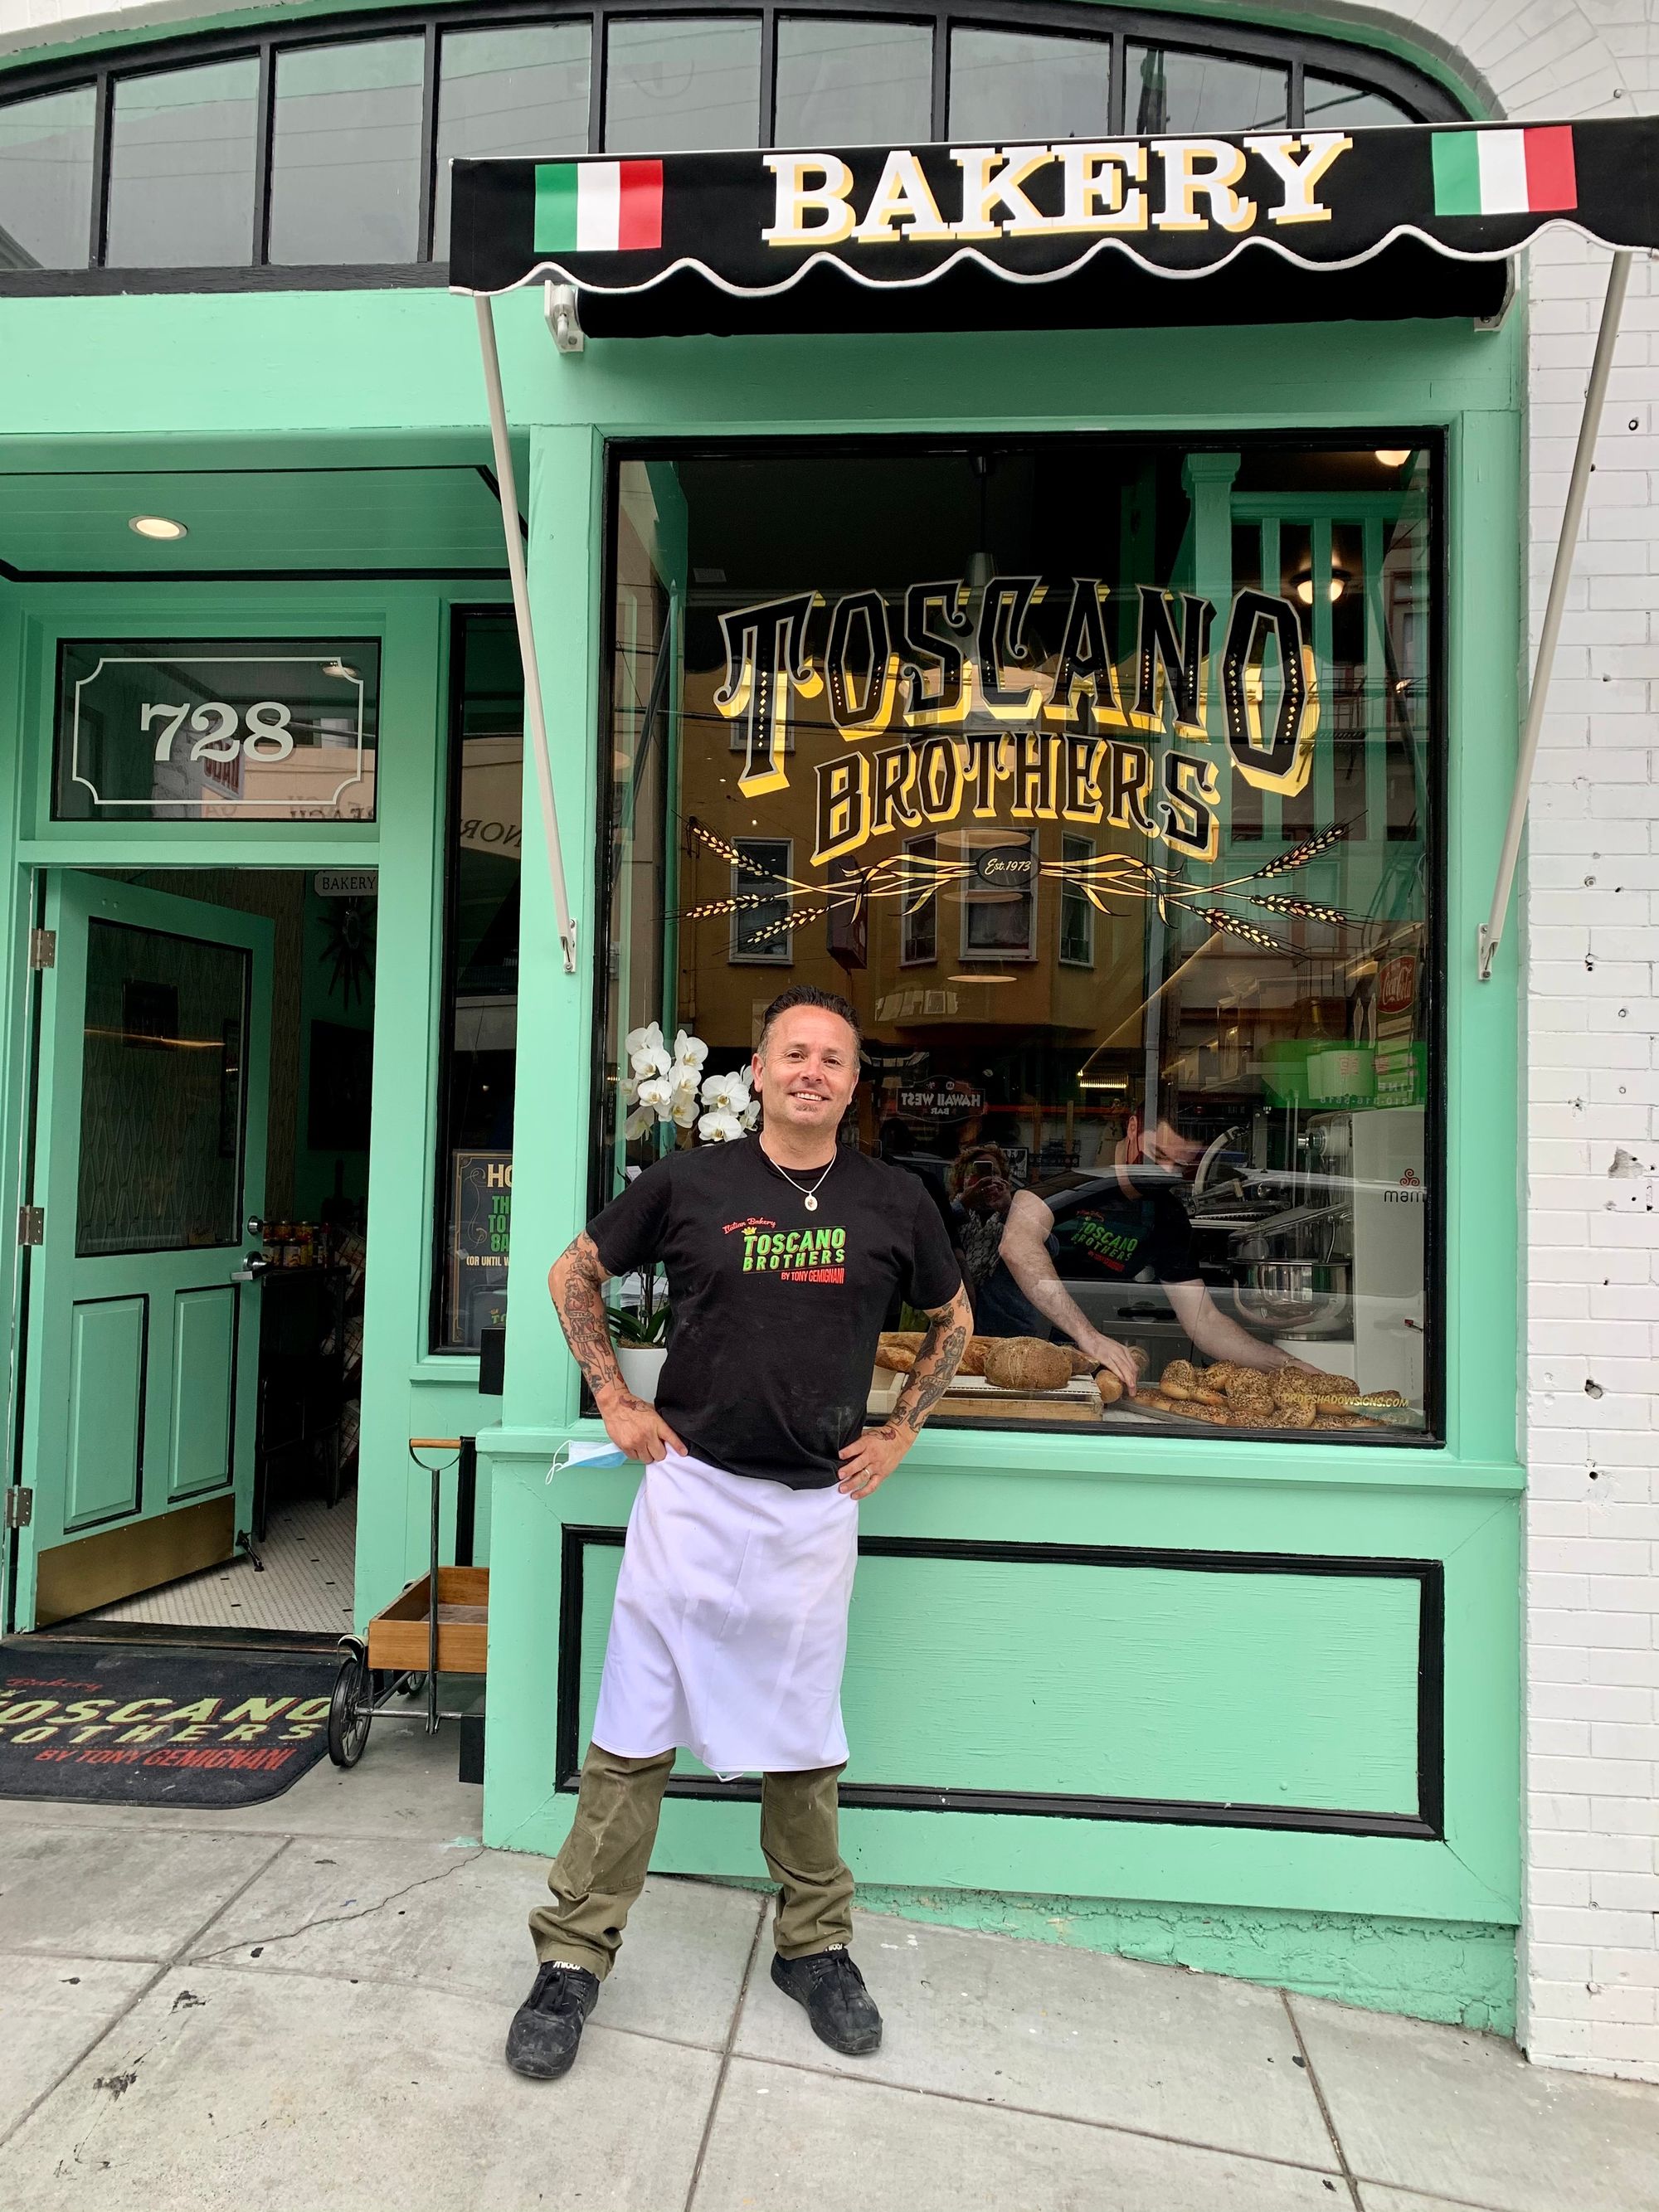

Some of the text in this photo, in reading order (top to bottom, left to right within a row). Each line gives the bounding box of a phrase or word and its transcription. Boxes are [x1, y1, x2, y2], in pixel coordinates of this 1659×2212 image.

[761, 131, 1354, 246] BAKERY
[713, 575, 1321, 798] TOSCANO
[140, 701, 294, 762] 728
[810, 731, 1220, 866] BROTHERS
[322, 876, 377, 890] BAKERY
[488, 1214, 507, 1233] TO
[747, 1217, 776, 1228] Bakery
[743, 1228, 846, 1256] TOSCANO
[1078, 1222, 1139, 1252] TOSCANO
[481, 1256, 503, 1266] UNTIL
[742, 1248, 846, 1272] BROTHERS
[781, 1267, 845, 1285] BY TONY GEMIGNANI
[0, 1697, 332, 1725] OSCANO
[0, 1723, 324, 1745] OTHERS
[34, 1748, 298, 1771] BY TONY GEMIGNANI
